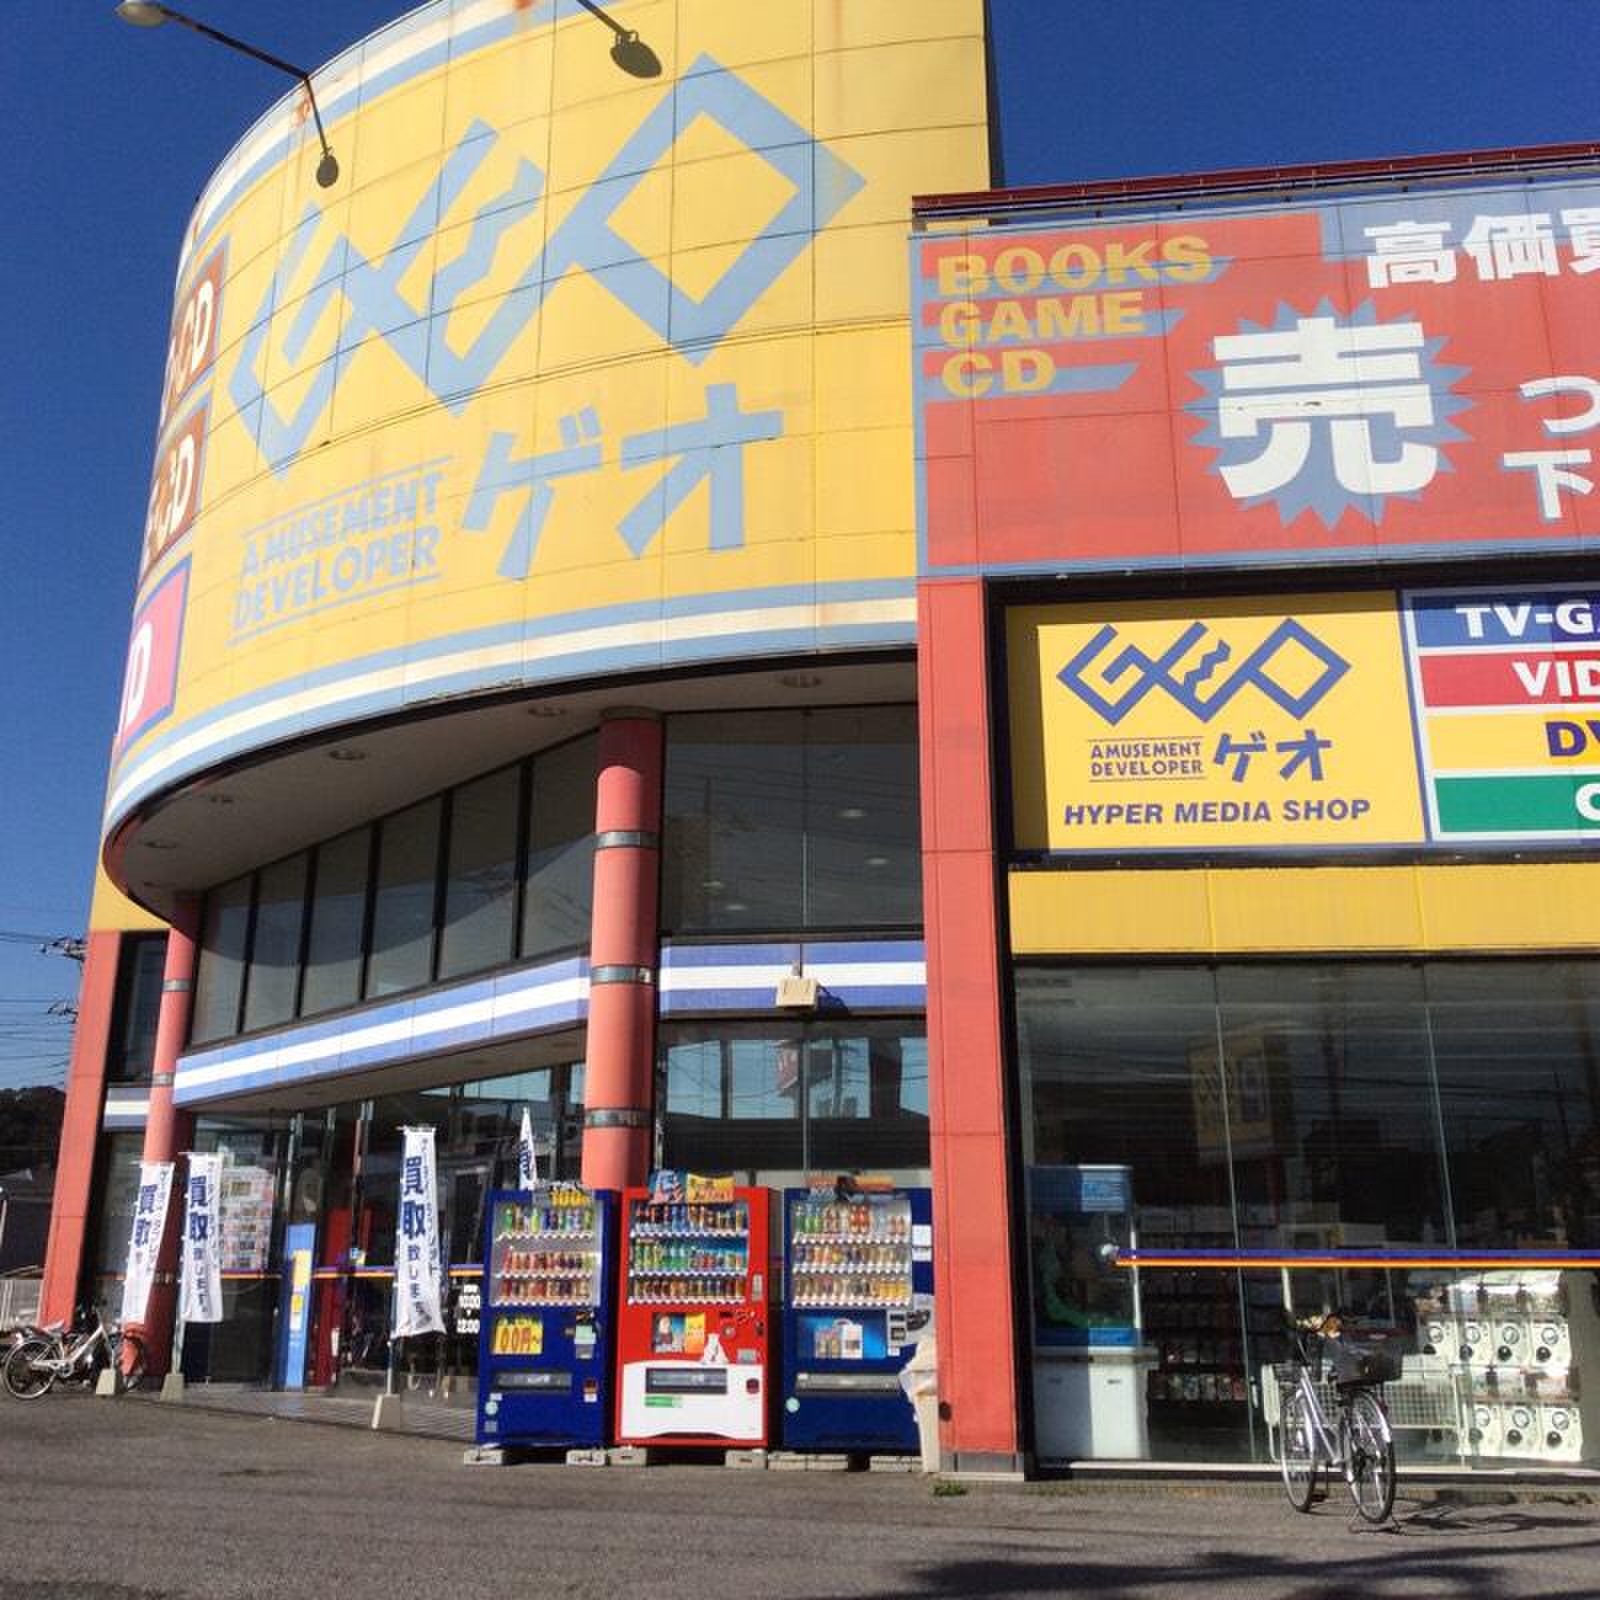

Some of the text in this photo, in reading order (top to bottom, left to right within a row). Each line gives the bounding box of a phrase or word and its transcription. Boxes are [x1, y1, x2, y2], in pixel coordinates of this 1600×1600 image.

[937, 235, 1212, 296] BOOKS
[939, 291, 1148, 348] GAME
[942, 350, 1056, 398] CD
[1214, 317, 1438, 498] 売
[461, 383, 784, 582] ゲオ
[1503, 448, 1594, 519] 下
[241, 470, 443, 567] AMUSEMENT
[233, 524, 441, 628] DEVELOPER
[1456, 601, 1600, 638] TV-G
[1512, 659, 1600, 697] VID
[1090, 759, 1202, 777] DEVELOPER
[1091, 740, 1201, 760] AMUSEMENT
[1213, 729, 1332, 783] ゲオ
[1064, 799, 1371, 825] HYPER MEDIA SHOP
